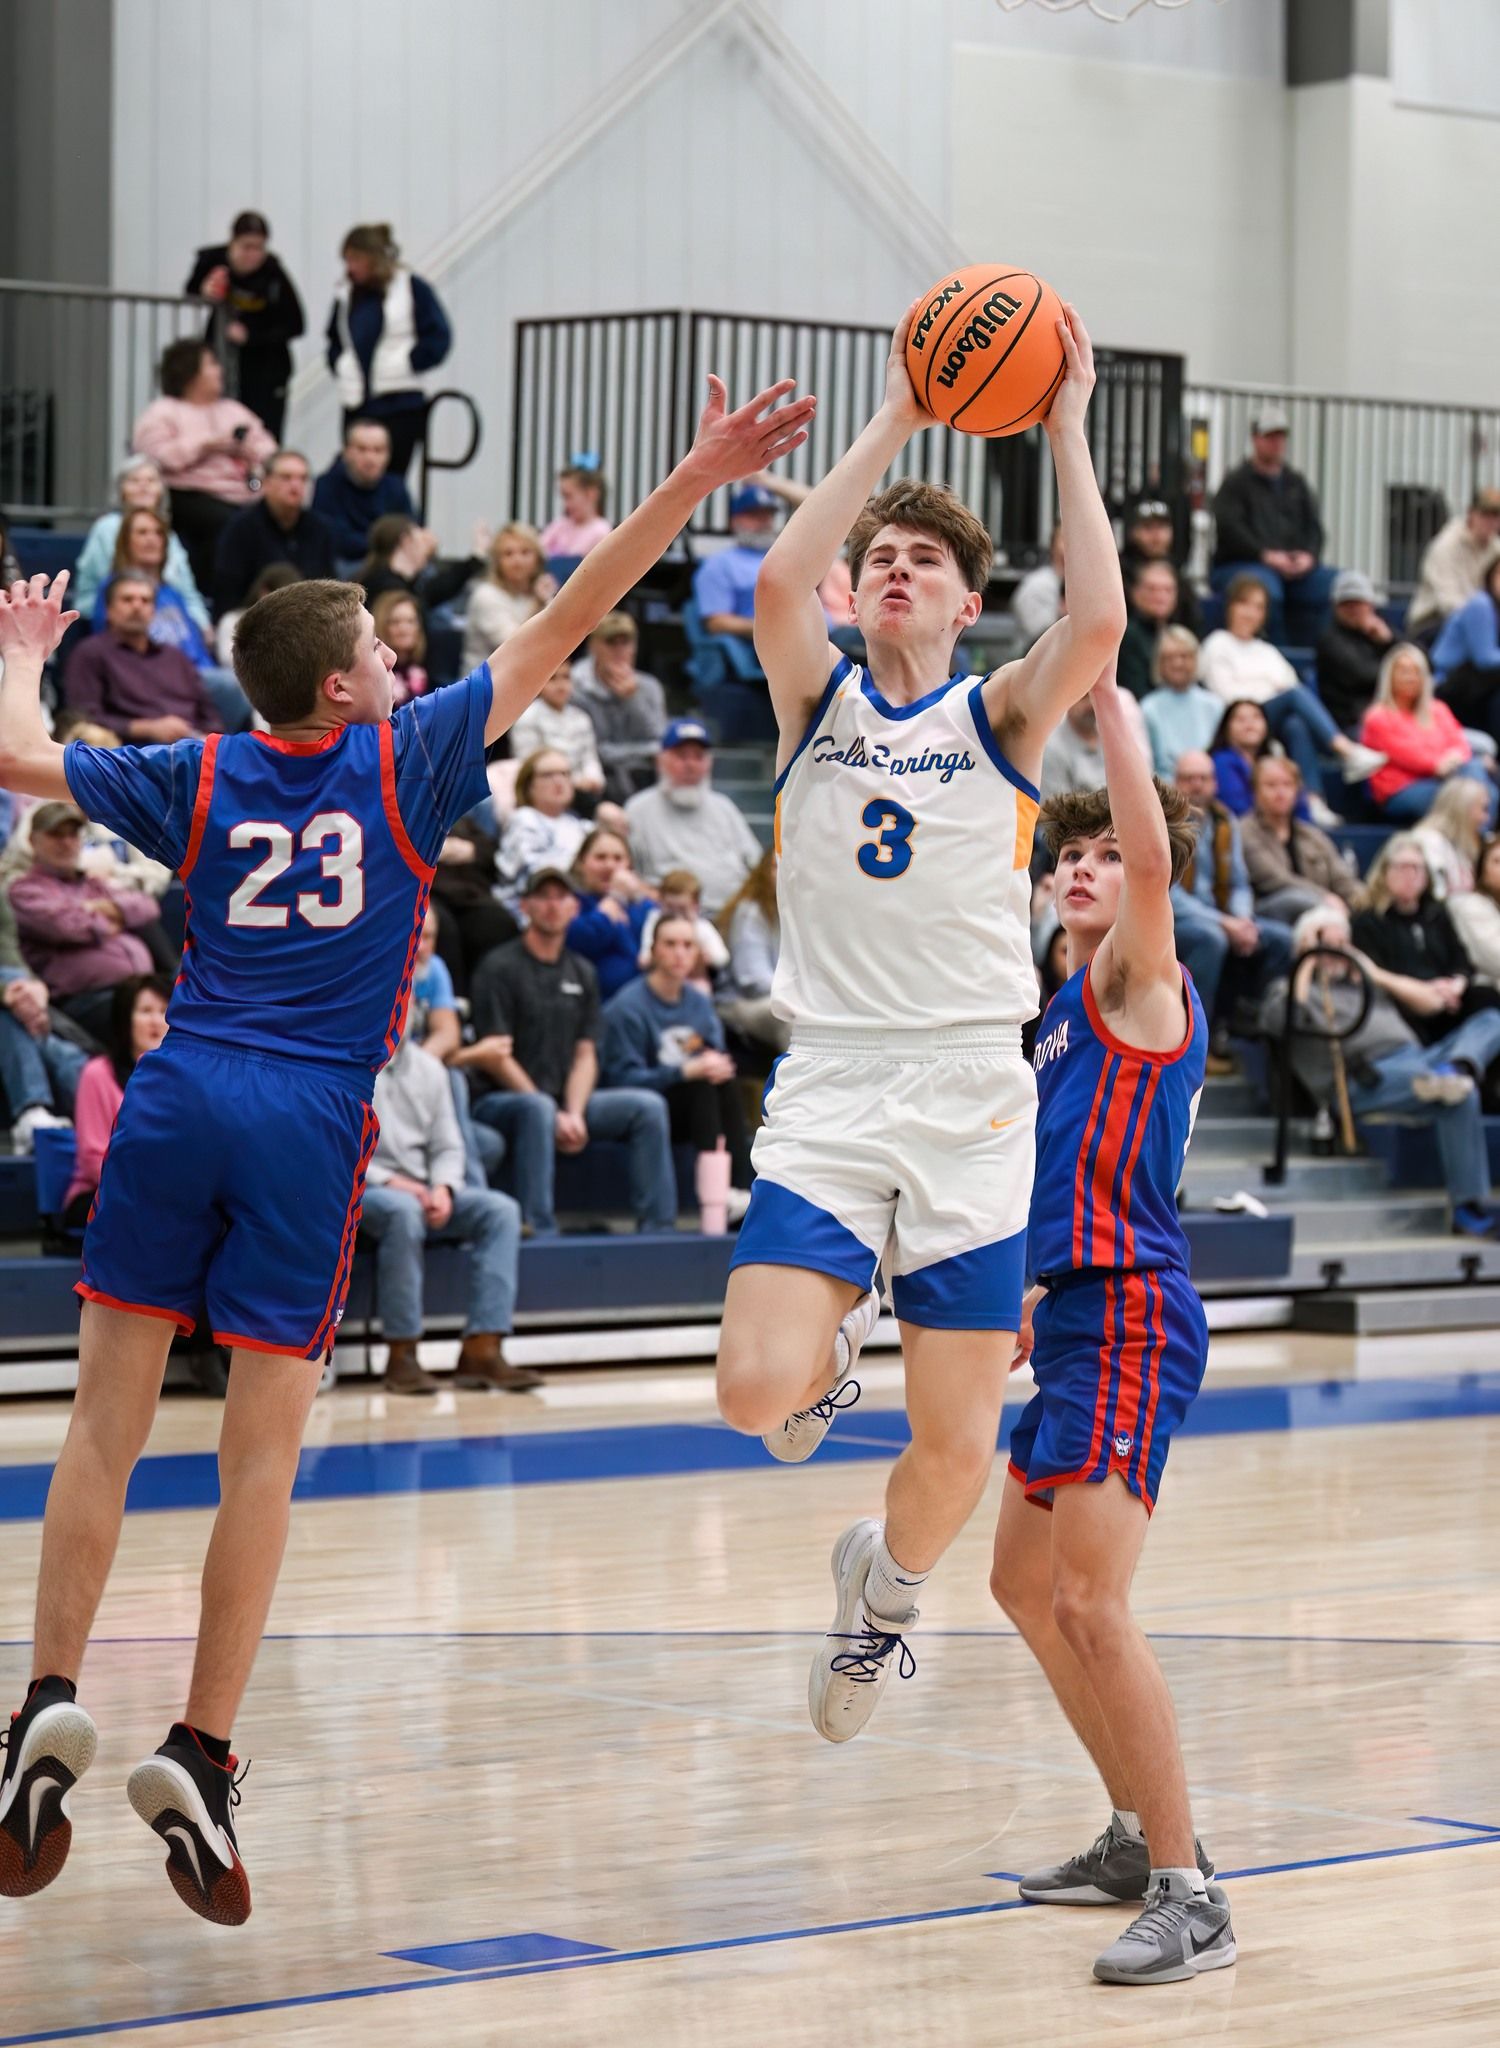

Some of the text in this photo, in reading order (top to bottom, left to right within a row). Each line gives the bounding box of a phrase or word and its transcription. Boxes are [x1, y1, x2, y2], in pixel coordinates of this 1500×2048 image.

[911, 279, 966, 351] NCAA
[936, 291, 1024, 389] Wilson
[871, 744, 977, 784] Springs
[225, 809, 367, 929] 23
[857, 797, 918, 881] 3
